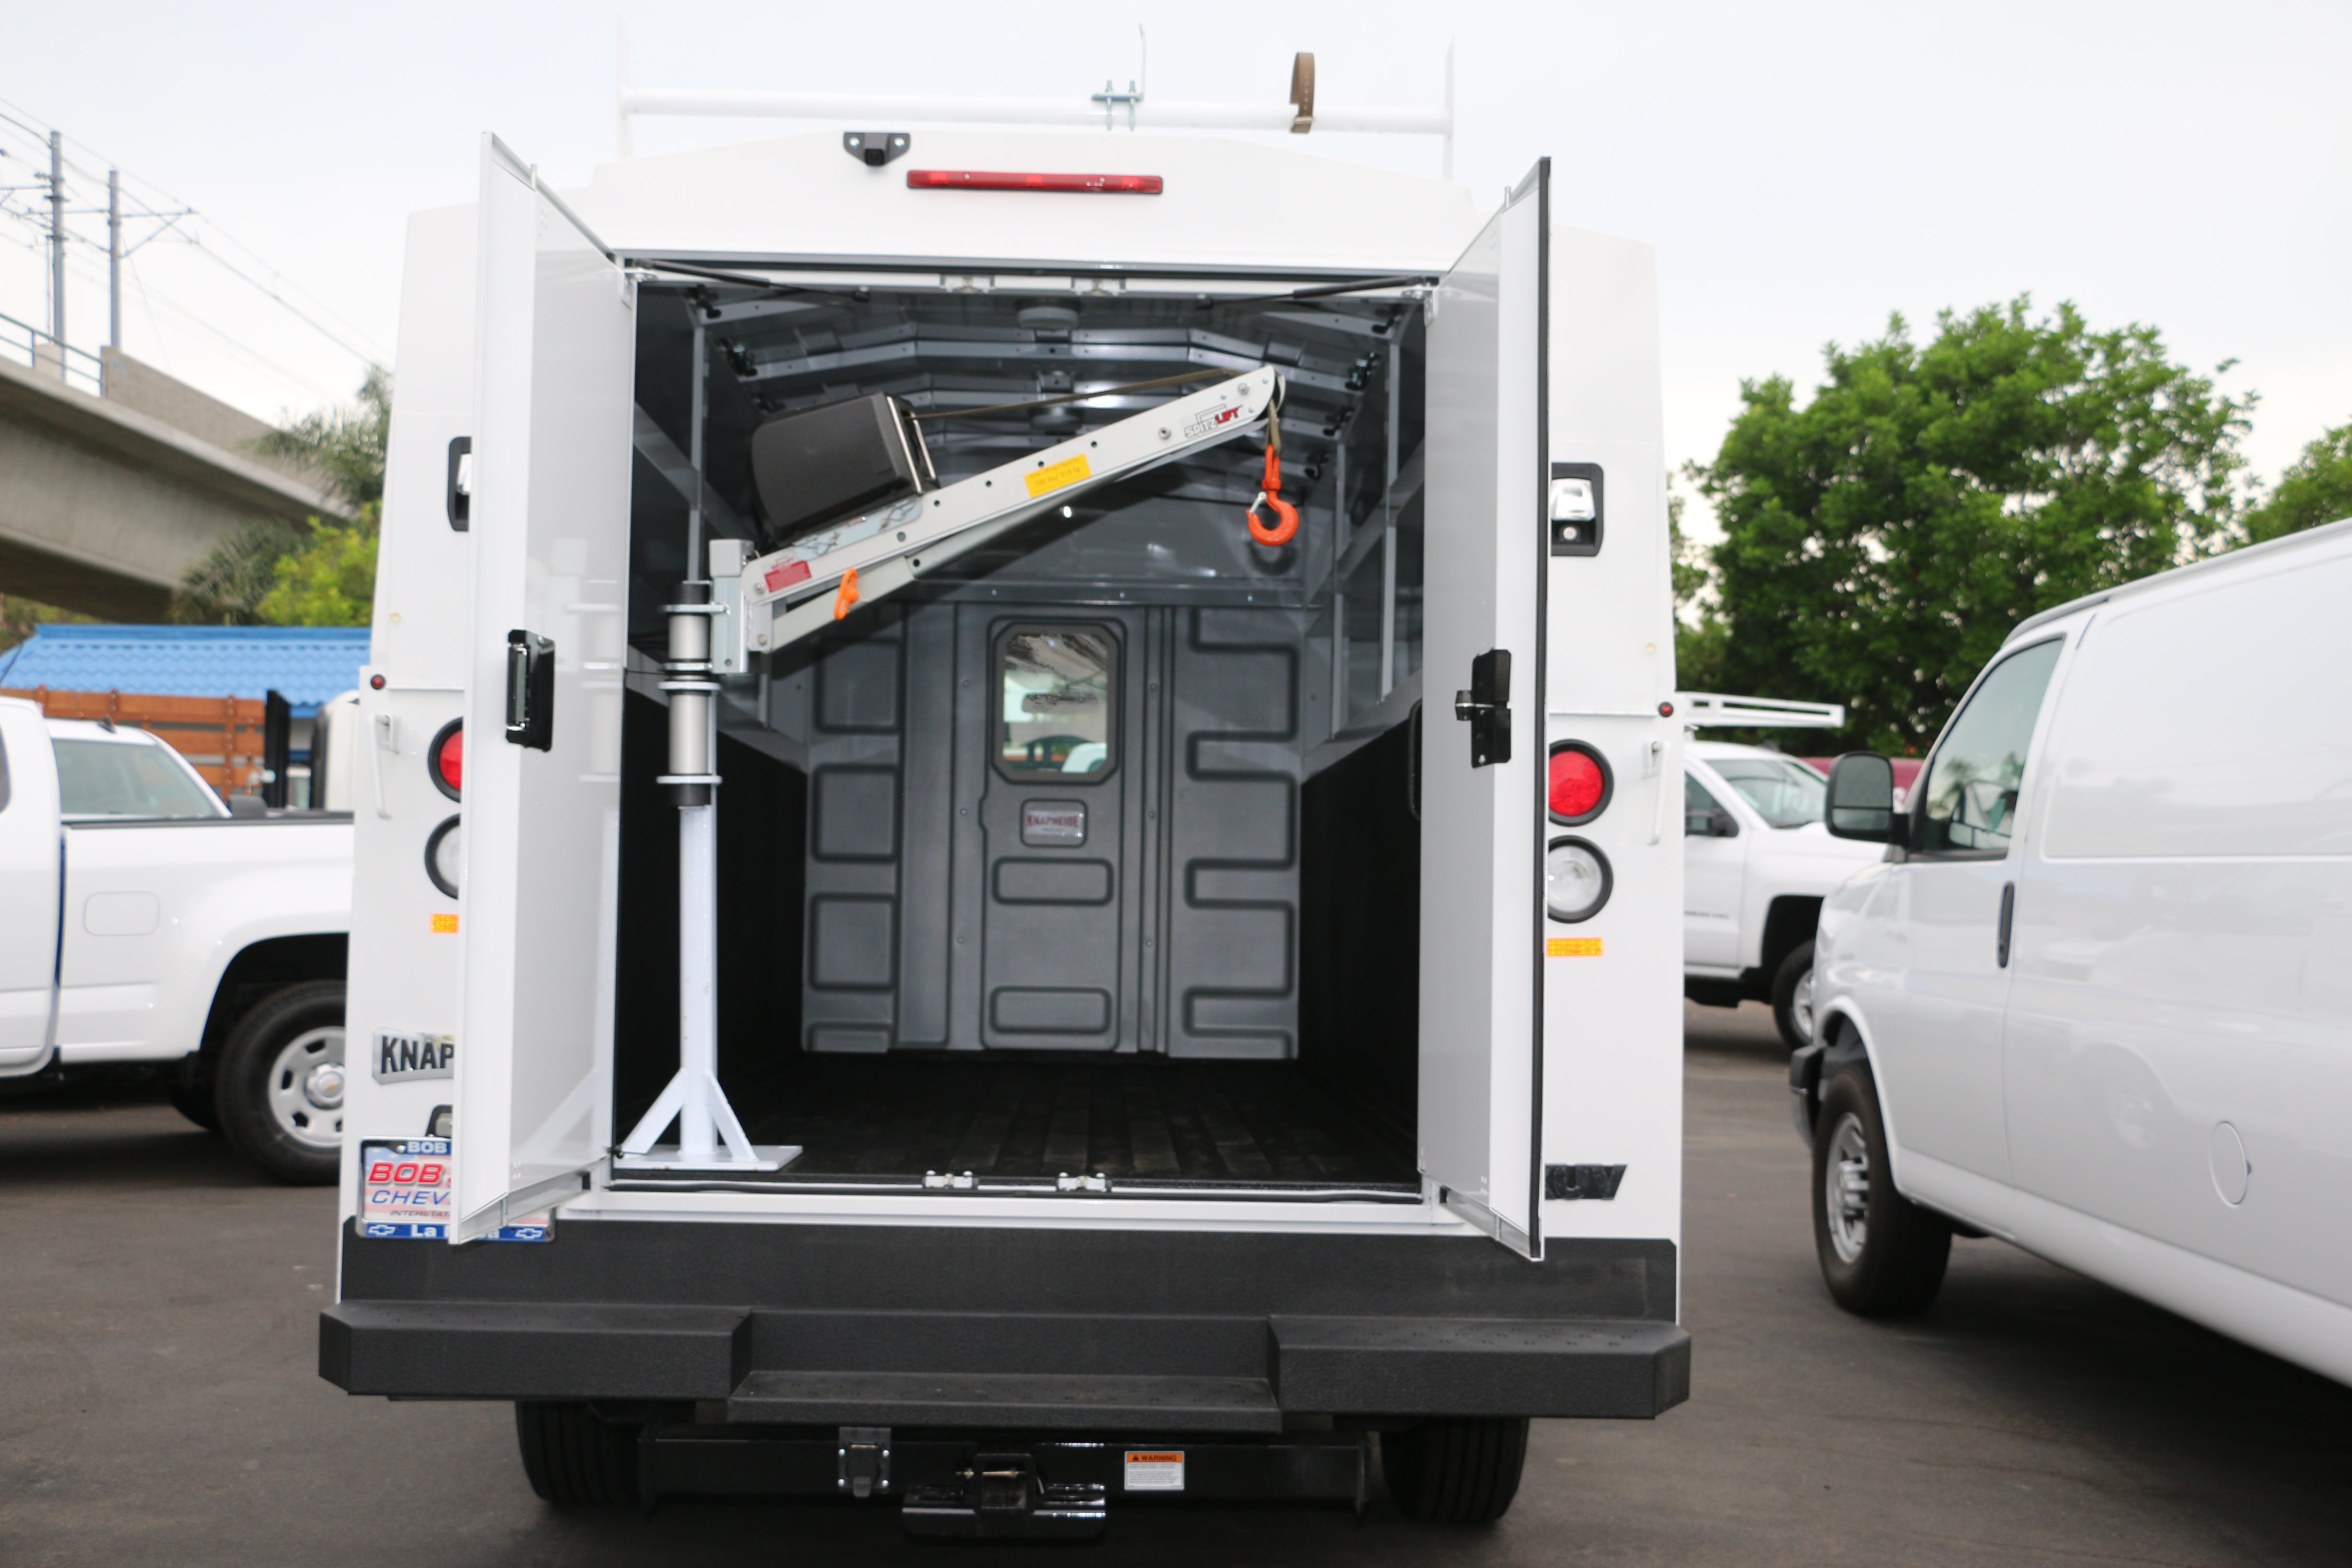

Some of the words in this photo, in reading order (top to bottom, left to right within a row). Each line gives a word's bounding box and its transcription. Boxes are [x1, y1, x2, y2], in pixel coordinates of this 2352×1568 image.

[1185, 405, 1242, 437] SPITZLIFT
[382, 1035, 454, 1074] KNAP
[407, 1142, 447, 1154] BOB
[368, 1162, 444, 1185] BOB
[372, 1190, 451, 1205] CHEV
[411, 1224, 437, 1237] La
